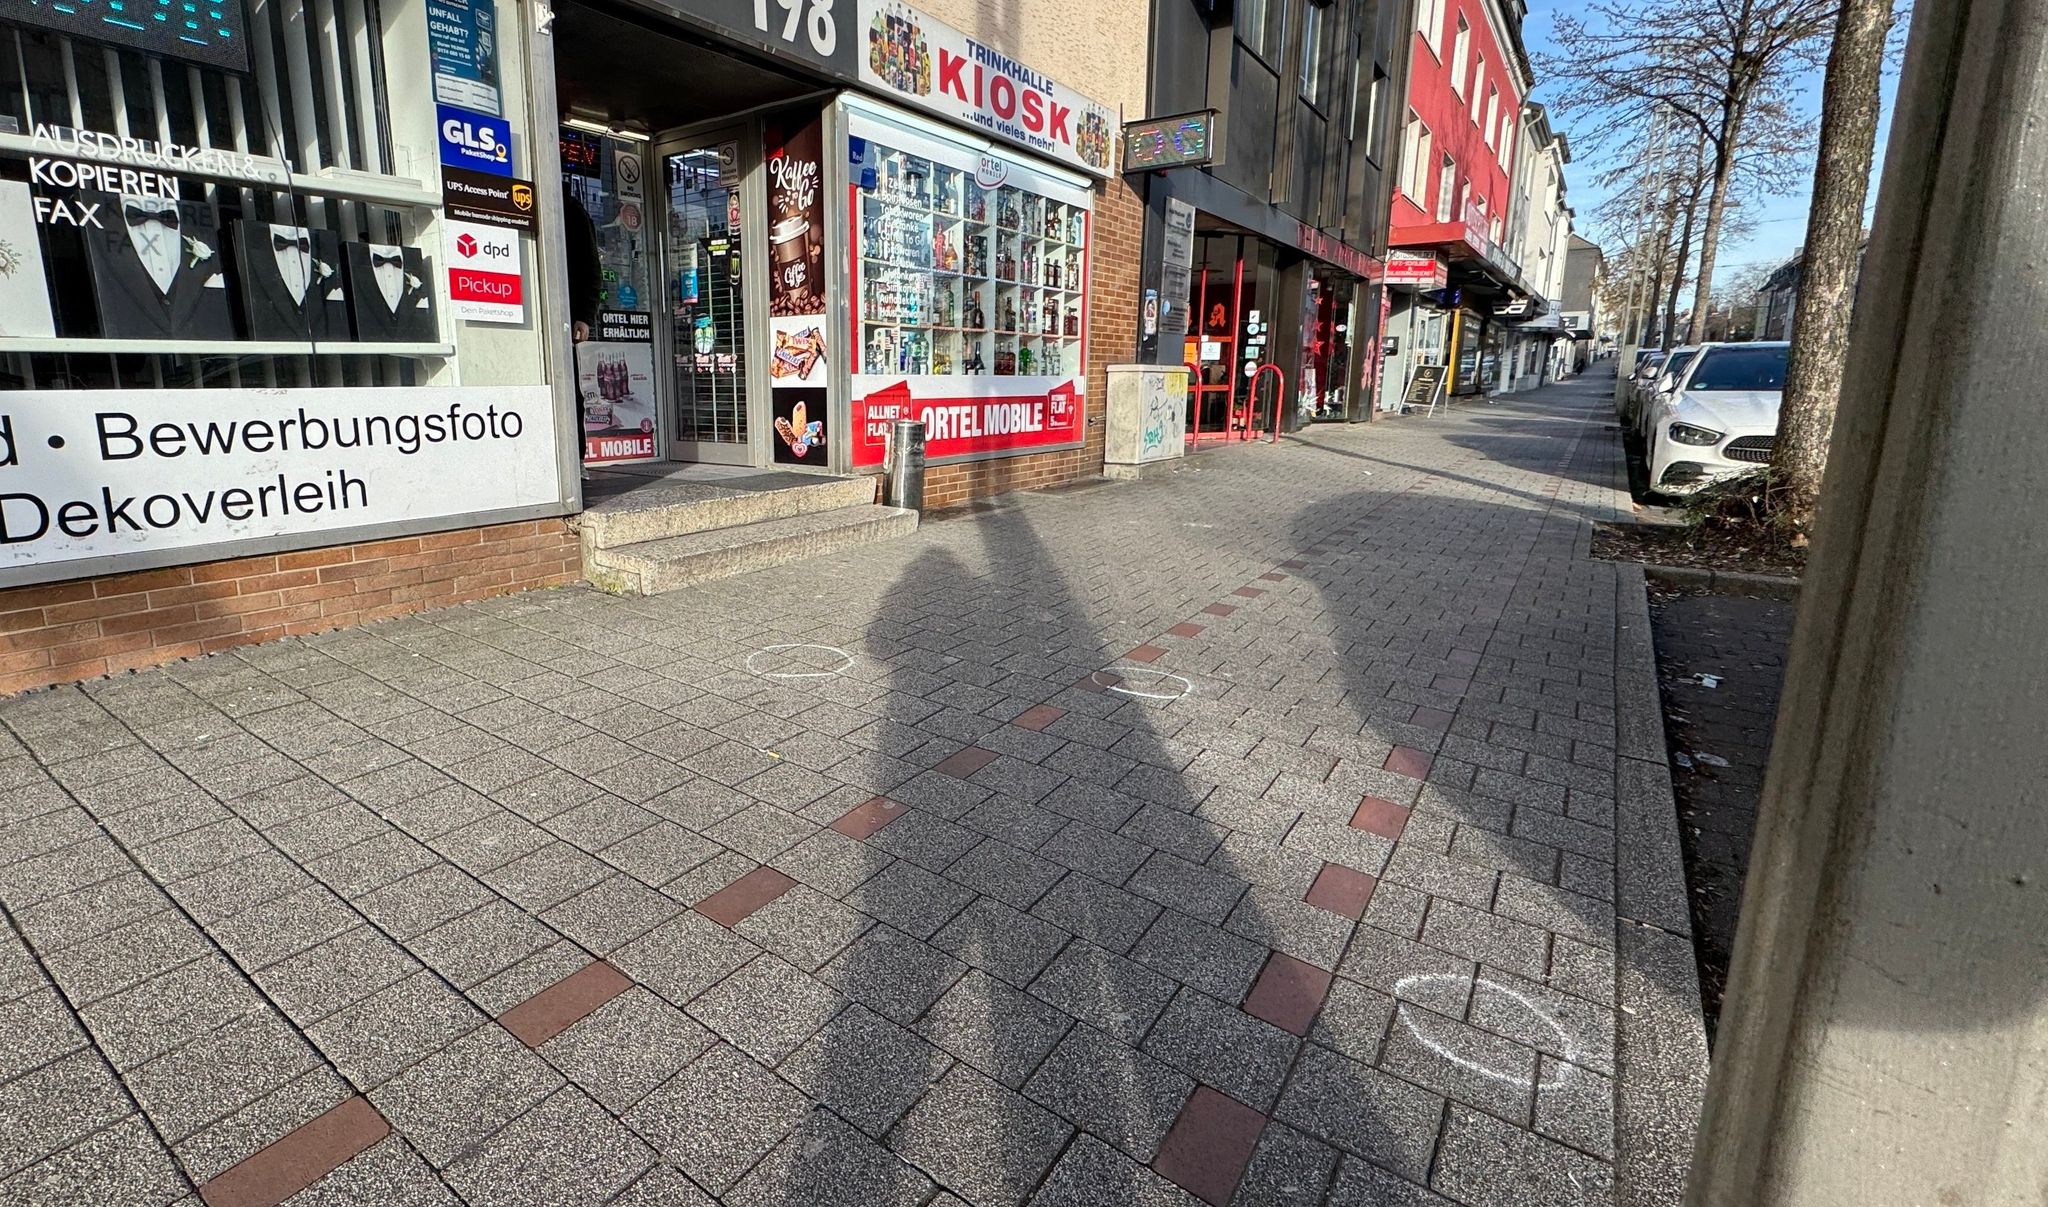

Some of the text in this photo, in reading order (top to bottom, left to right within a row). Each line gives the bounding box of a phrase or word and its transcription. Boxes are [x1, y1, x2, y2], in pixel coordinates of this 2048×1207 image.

[429, 6, 462, 23] UNFALL
[430, 21, 469, 38] GEHABT?
[966, 38, 1053, 97] TRINKHALLE
[939, 47, 1071, 145] KIOSK
[443, 120, 496, 152] GLS
[997, 121, 1026, 141] vieles
[1029, 135, 1055, 153] mehr!
[31, 123, 262, 179] AUSDRUCKEN &
[461, 147, 496, 162] PaketShop
[770, 155, 816, 191] Kaffee
[981, 157, 1002, 172] ortel
[28, 157, 180, 200] KOPIEREN
[447, 181, 508, 199] UPS Access Point
[515, 191, 531, 207] ups
[798, 178, 815, 211] Go
[33, 196, 104, 229] FAX
[628, 215, 638, 226] 18
[905, 234, 914, 244] To
[483, 241, 510, 259] dpd
[458, 276, 513, 298] Pickup
[461, 306, 514, 317] Dein Paketshop
[602, 313, 649, 325] ORTEL HIER
[603, 326, 650, 339] ERHÄLTLICH
[868, 405, 901, 420] ALLNET
[1051, 401, 1067, 415] FLAT
[920, 403, 1044, 442] ORTEL MOBILE
[95, 403, 524, 462] Bewerbungsfoto
[600, 438, 652, 458] MOBILE
[0, 470, 369, 544] Dekoverleih
